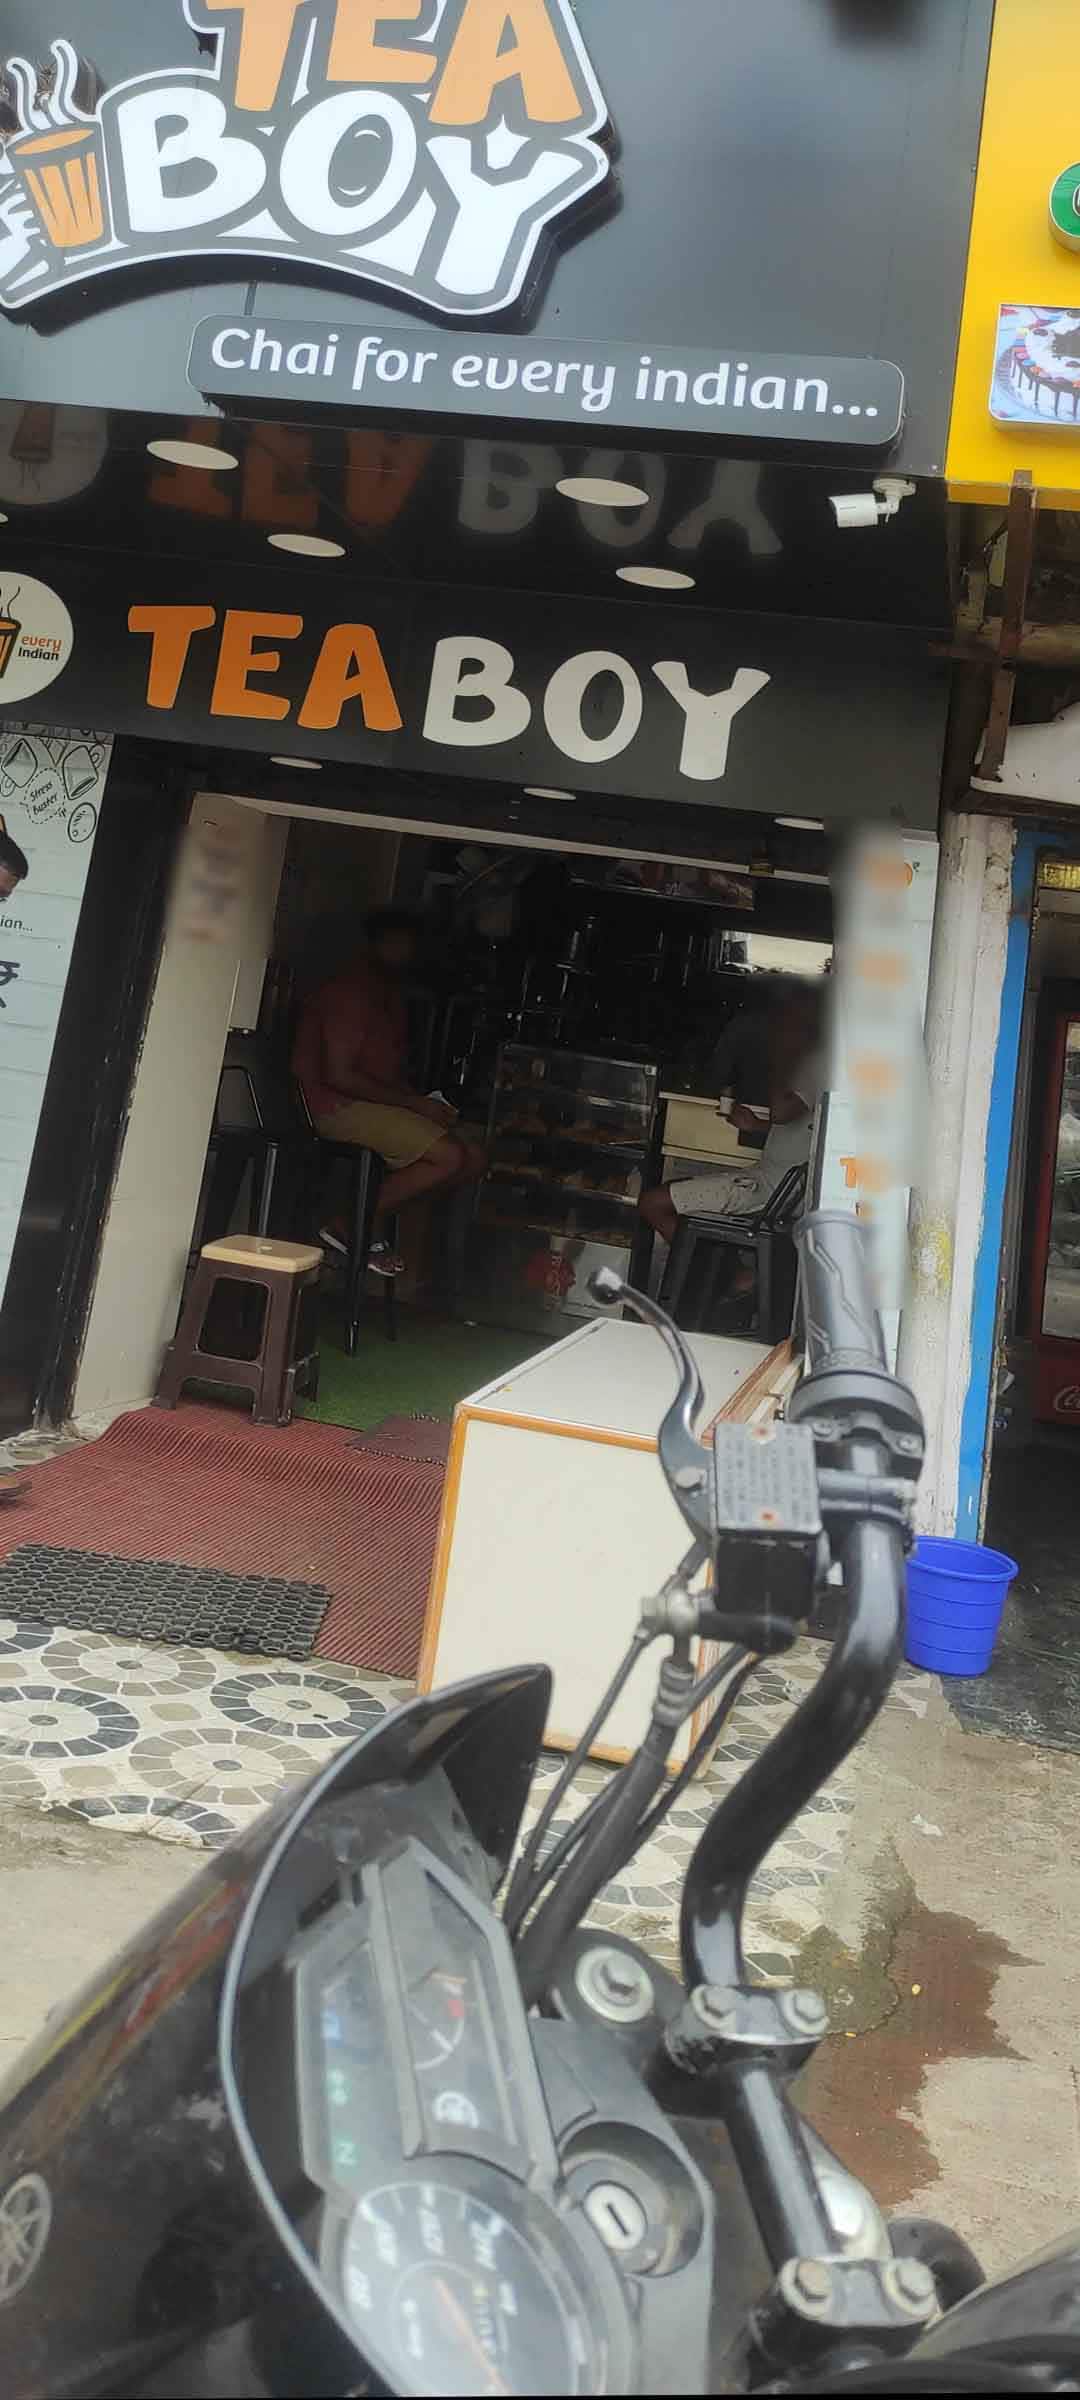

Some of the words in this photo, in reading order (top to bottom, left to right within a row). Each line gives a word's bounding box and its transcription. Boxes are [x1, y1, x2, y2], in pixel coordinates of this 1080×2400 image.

[207, 0, 583, 126] TEA
[117, 87, 583, 295] BOY
[211, 327, 337, 377] Chai
[352, 335, 439, 391] for
[451, 352, 615, 412] every
[635, 356, 878, 417] indian...
[21, 635, 62, 652] every
[127, 605, 403, 732] TEA
[423, 635, 772, 781] BOY
